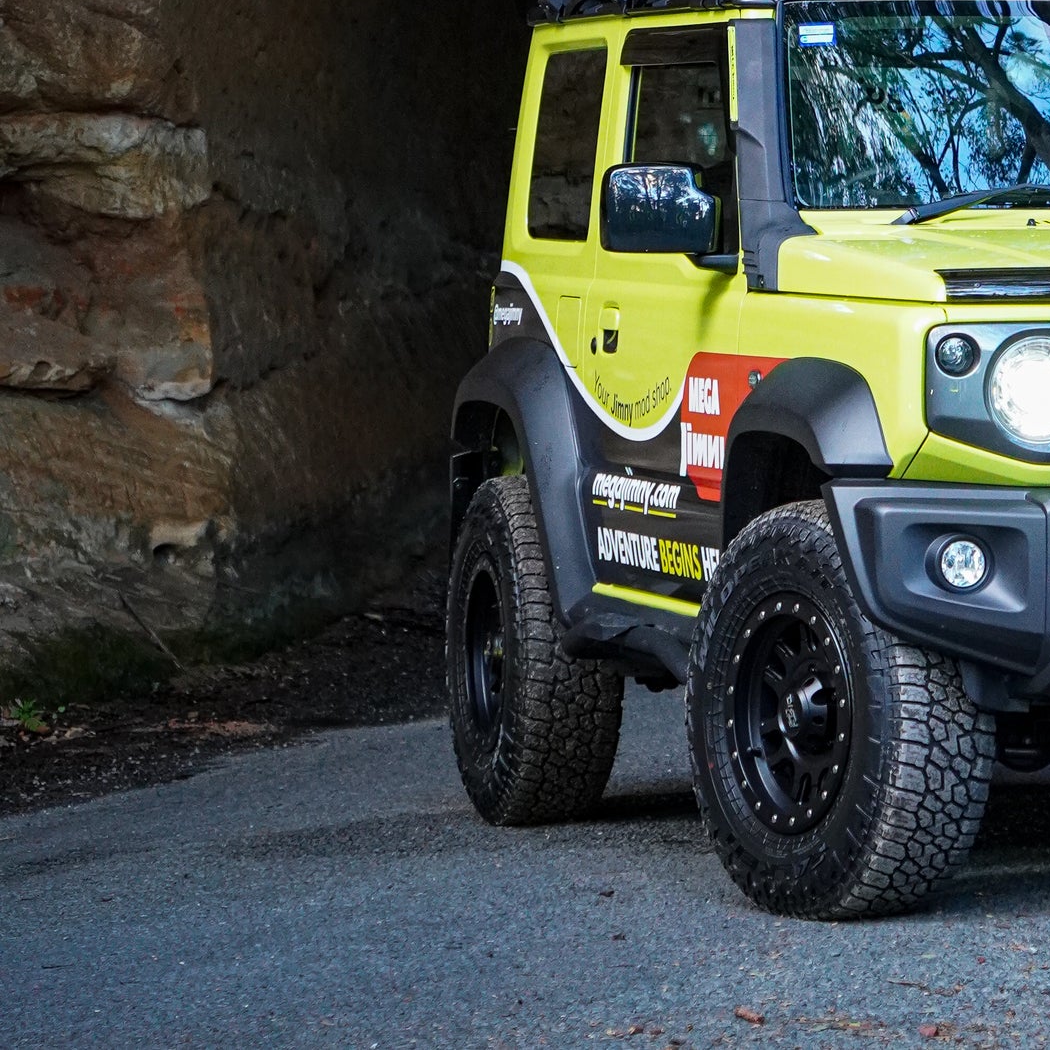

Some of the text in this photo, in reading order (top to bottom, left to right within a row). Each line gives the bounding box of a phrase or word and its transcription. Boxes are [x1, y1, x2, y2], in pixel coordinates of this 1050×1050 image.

[594, 370, 672, 427] Your Jimny mod shop.
[688, 376, 720, 415] MEGA
[592, 467, 681, 515] megajimny.com
[597, 526, 660, 572] ADVENTURE
[658, 538, 702, 581] BEGINS
